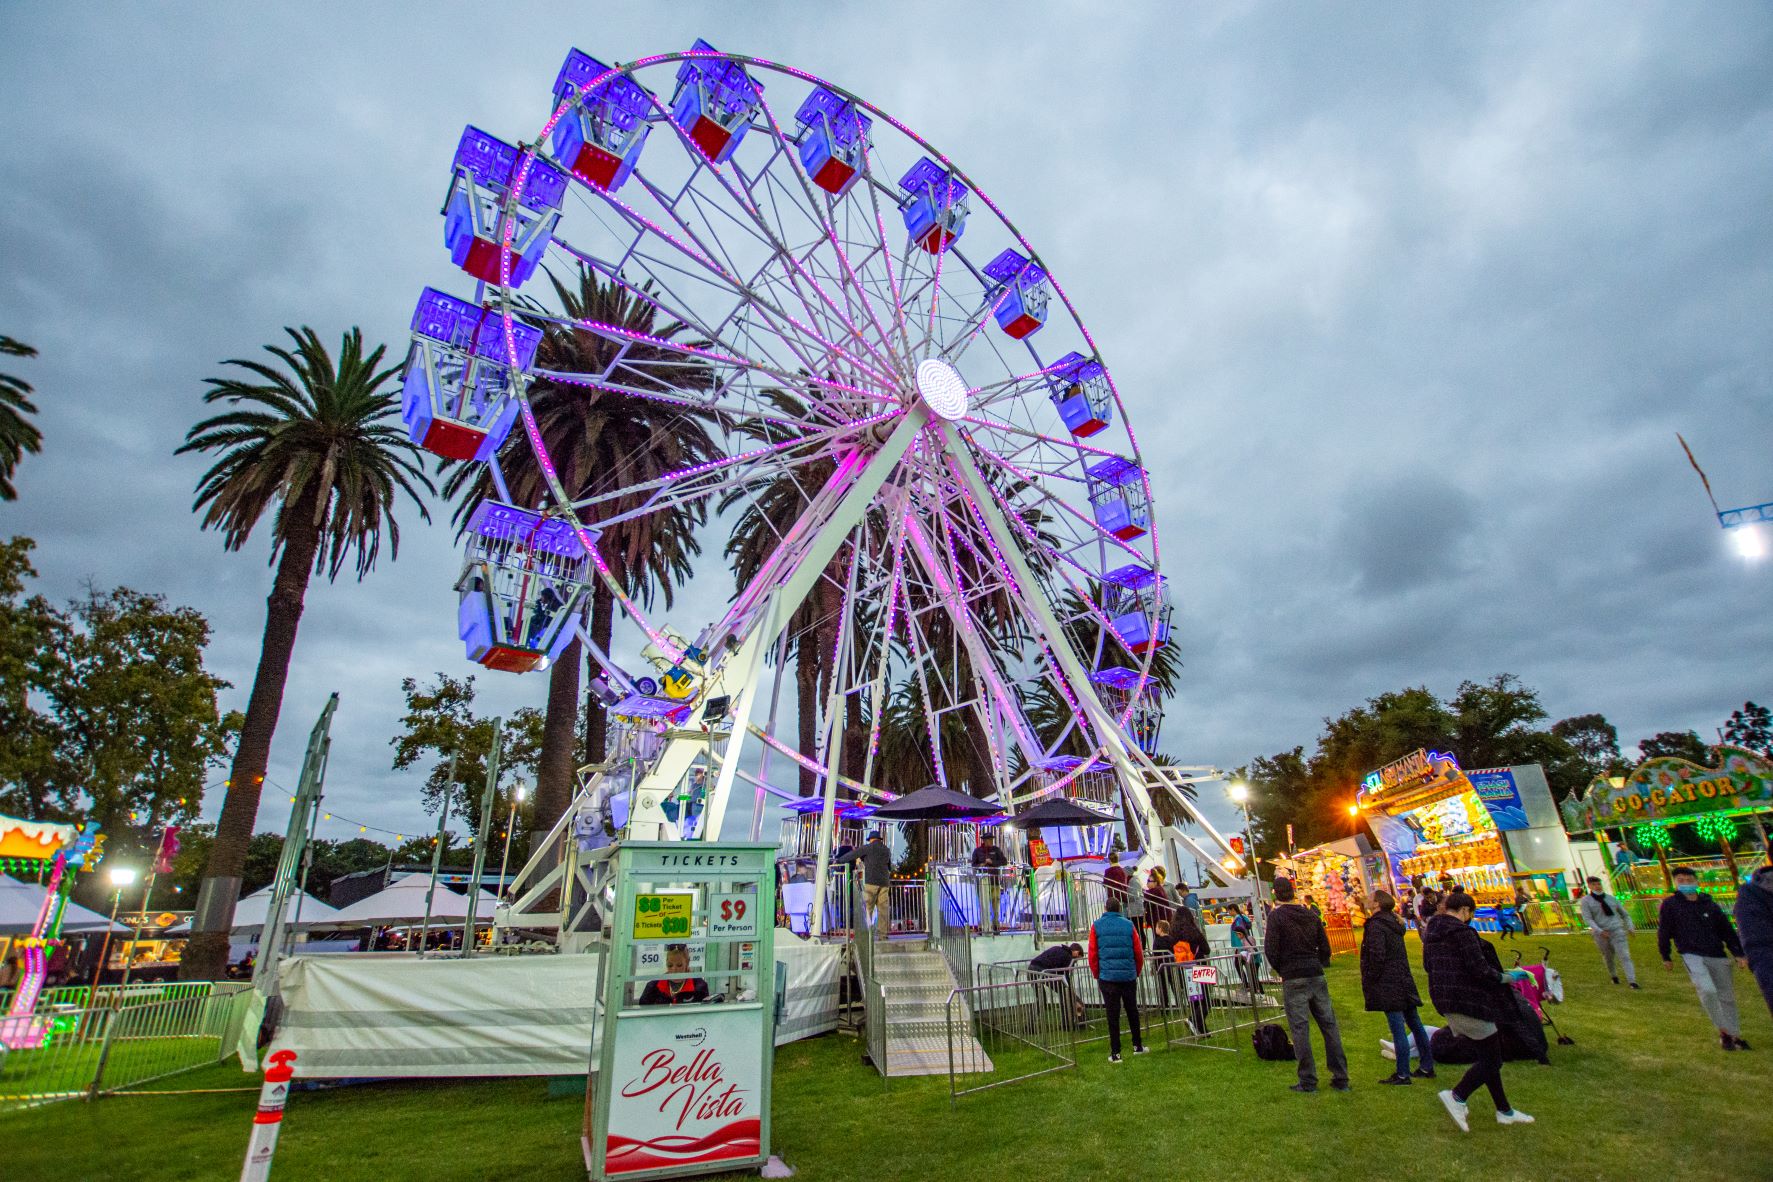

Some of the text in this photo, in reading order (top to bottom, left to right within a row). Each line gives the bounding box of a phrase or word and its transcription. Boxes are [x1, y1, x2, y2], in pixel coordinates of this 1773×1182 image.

[661, 855, 739, 866] TICKETS
[721, 899, 746, 922] $9
[642, 954, 659, 964] $50
[1193, 968, 1216, 979] ENTRY
[621, 1048, 726, 1098] Bella
[658, 1077, 752, 1131] Vista
